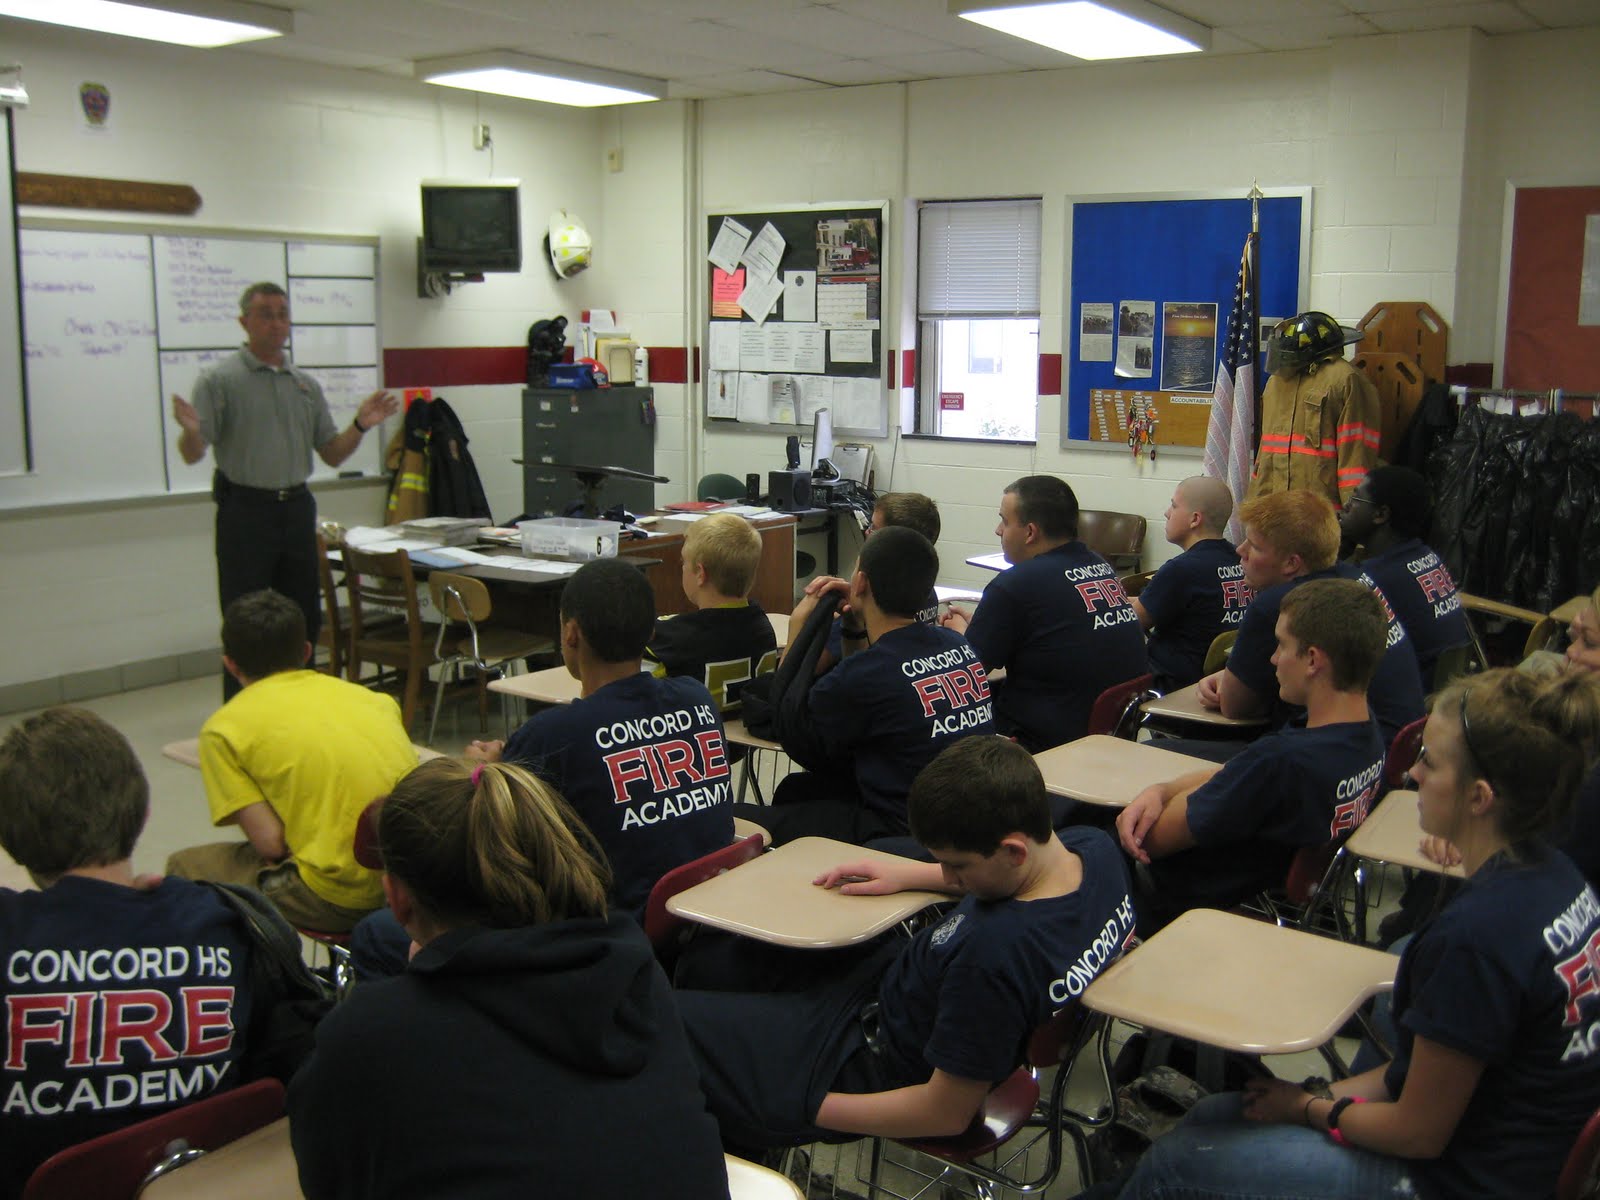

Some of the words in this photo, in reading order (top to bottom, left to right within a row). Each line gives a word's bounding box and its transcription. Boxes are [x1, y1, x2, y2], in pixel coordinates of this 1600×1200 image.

[596, 536, 602, 555] 6
[1093, 607, 1138, 630] ACADE
[901, 648, 963, 678] CONCORD
[911, 661, 991, 718] FIRE
[595, 709, 692, 749] CONCORD
[694, 704, 716, 726] HS
[930, 701, 993, 738] ACADEM
[602, 729, 729, 804] FIRE
[621, 780, 731, 831] ACADEMY
[7, 946, 190, 984] CONCORD
[197, 945, 232, 978] HS
[1049, 918, 1119, 1003] CONCORD
[4, 986, 236, 1071] FIRE
[2, 1061, 232, 1115] ACADEMY
